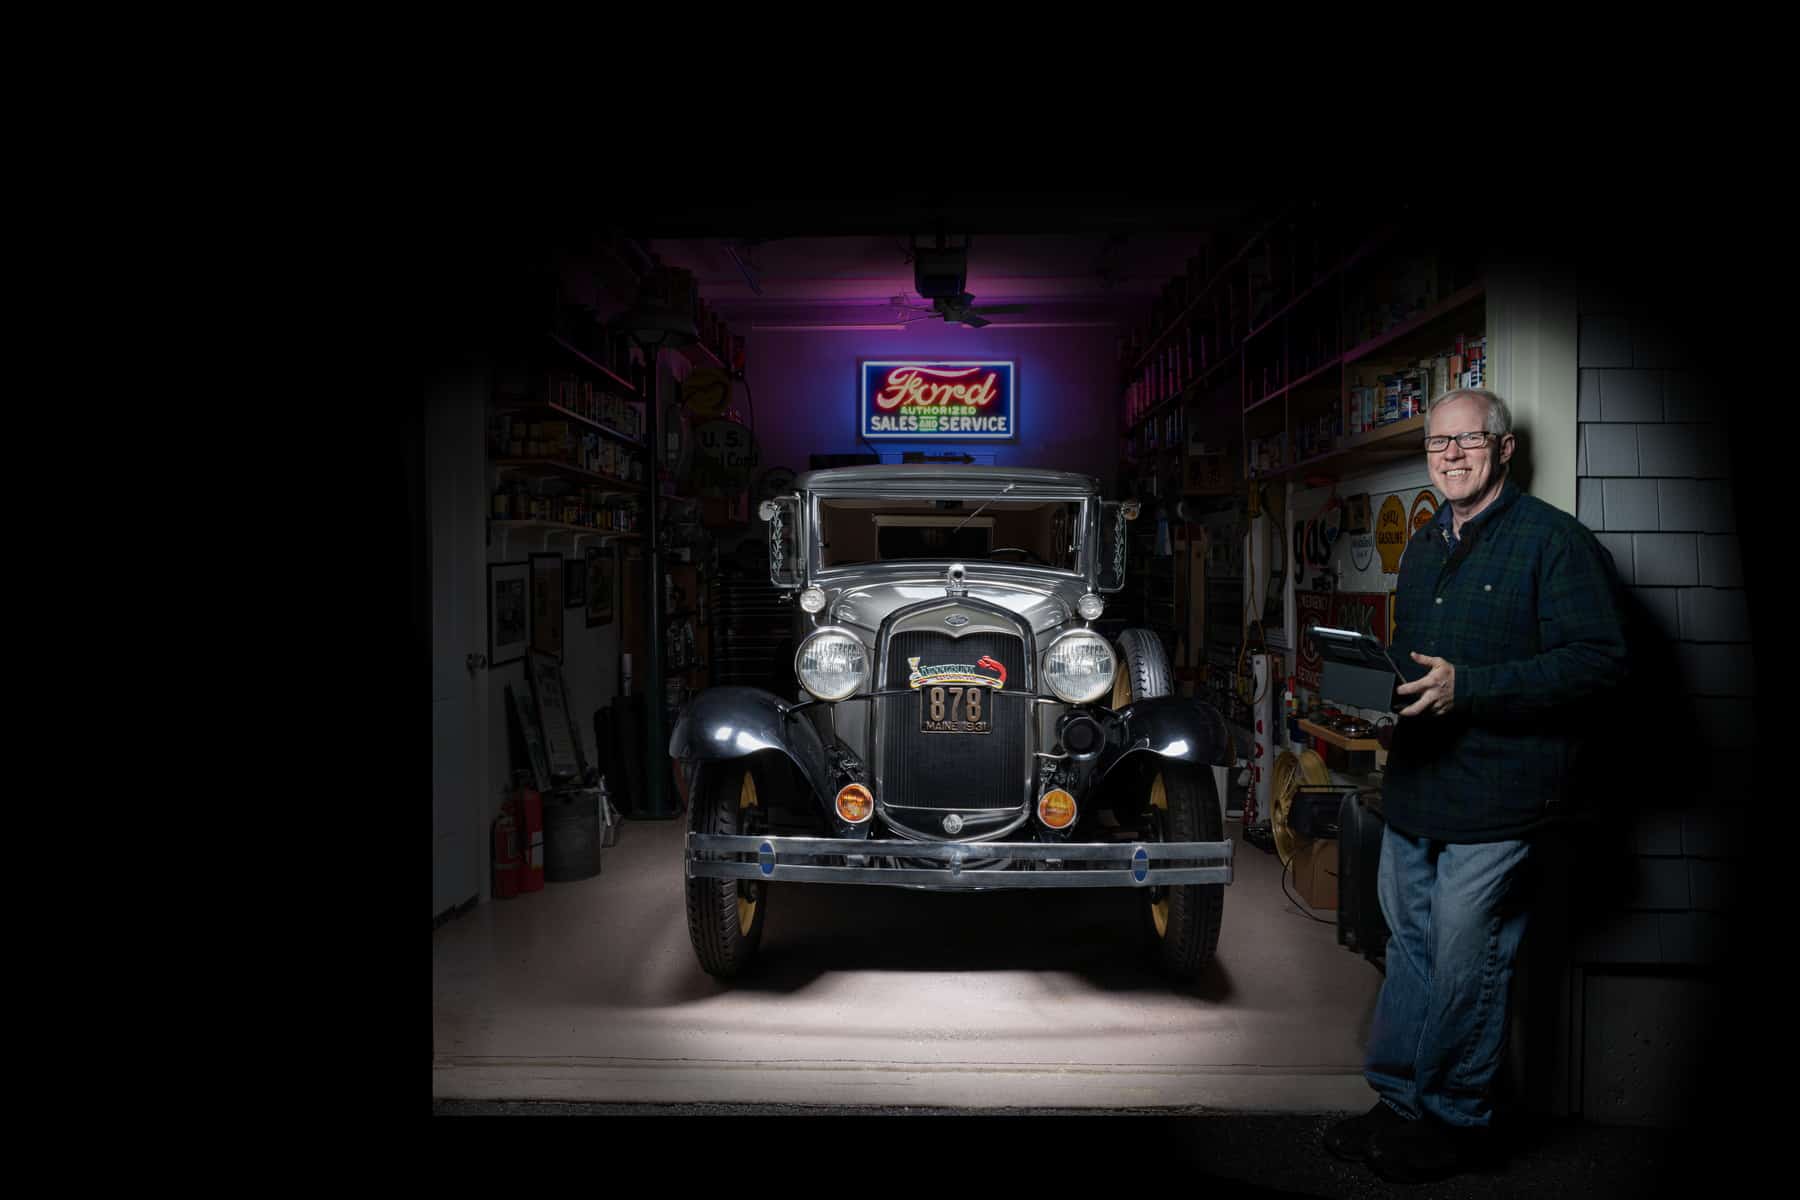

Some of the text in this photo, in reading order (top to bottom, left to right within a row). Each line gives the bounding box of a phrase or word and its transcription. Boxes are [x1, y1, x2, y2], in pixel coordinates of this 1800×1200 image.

[876, 367, 997, 409] Ford
[900, 406, 977, 415] AUTHORIZED
[870, 416, 918, 431] SALES
[939, 416, 1008, 432] SERVICE
[1377, 531, 1404, 545] GASOLINE
[930, 687, 981, 721] 878
[925, 721, 958, 731] MAINE
